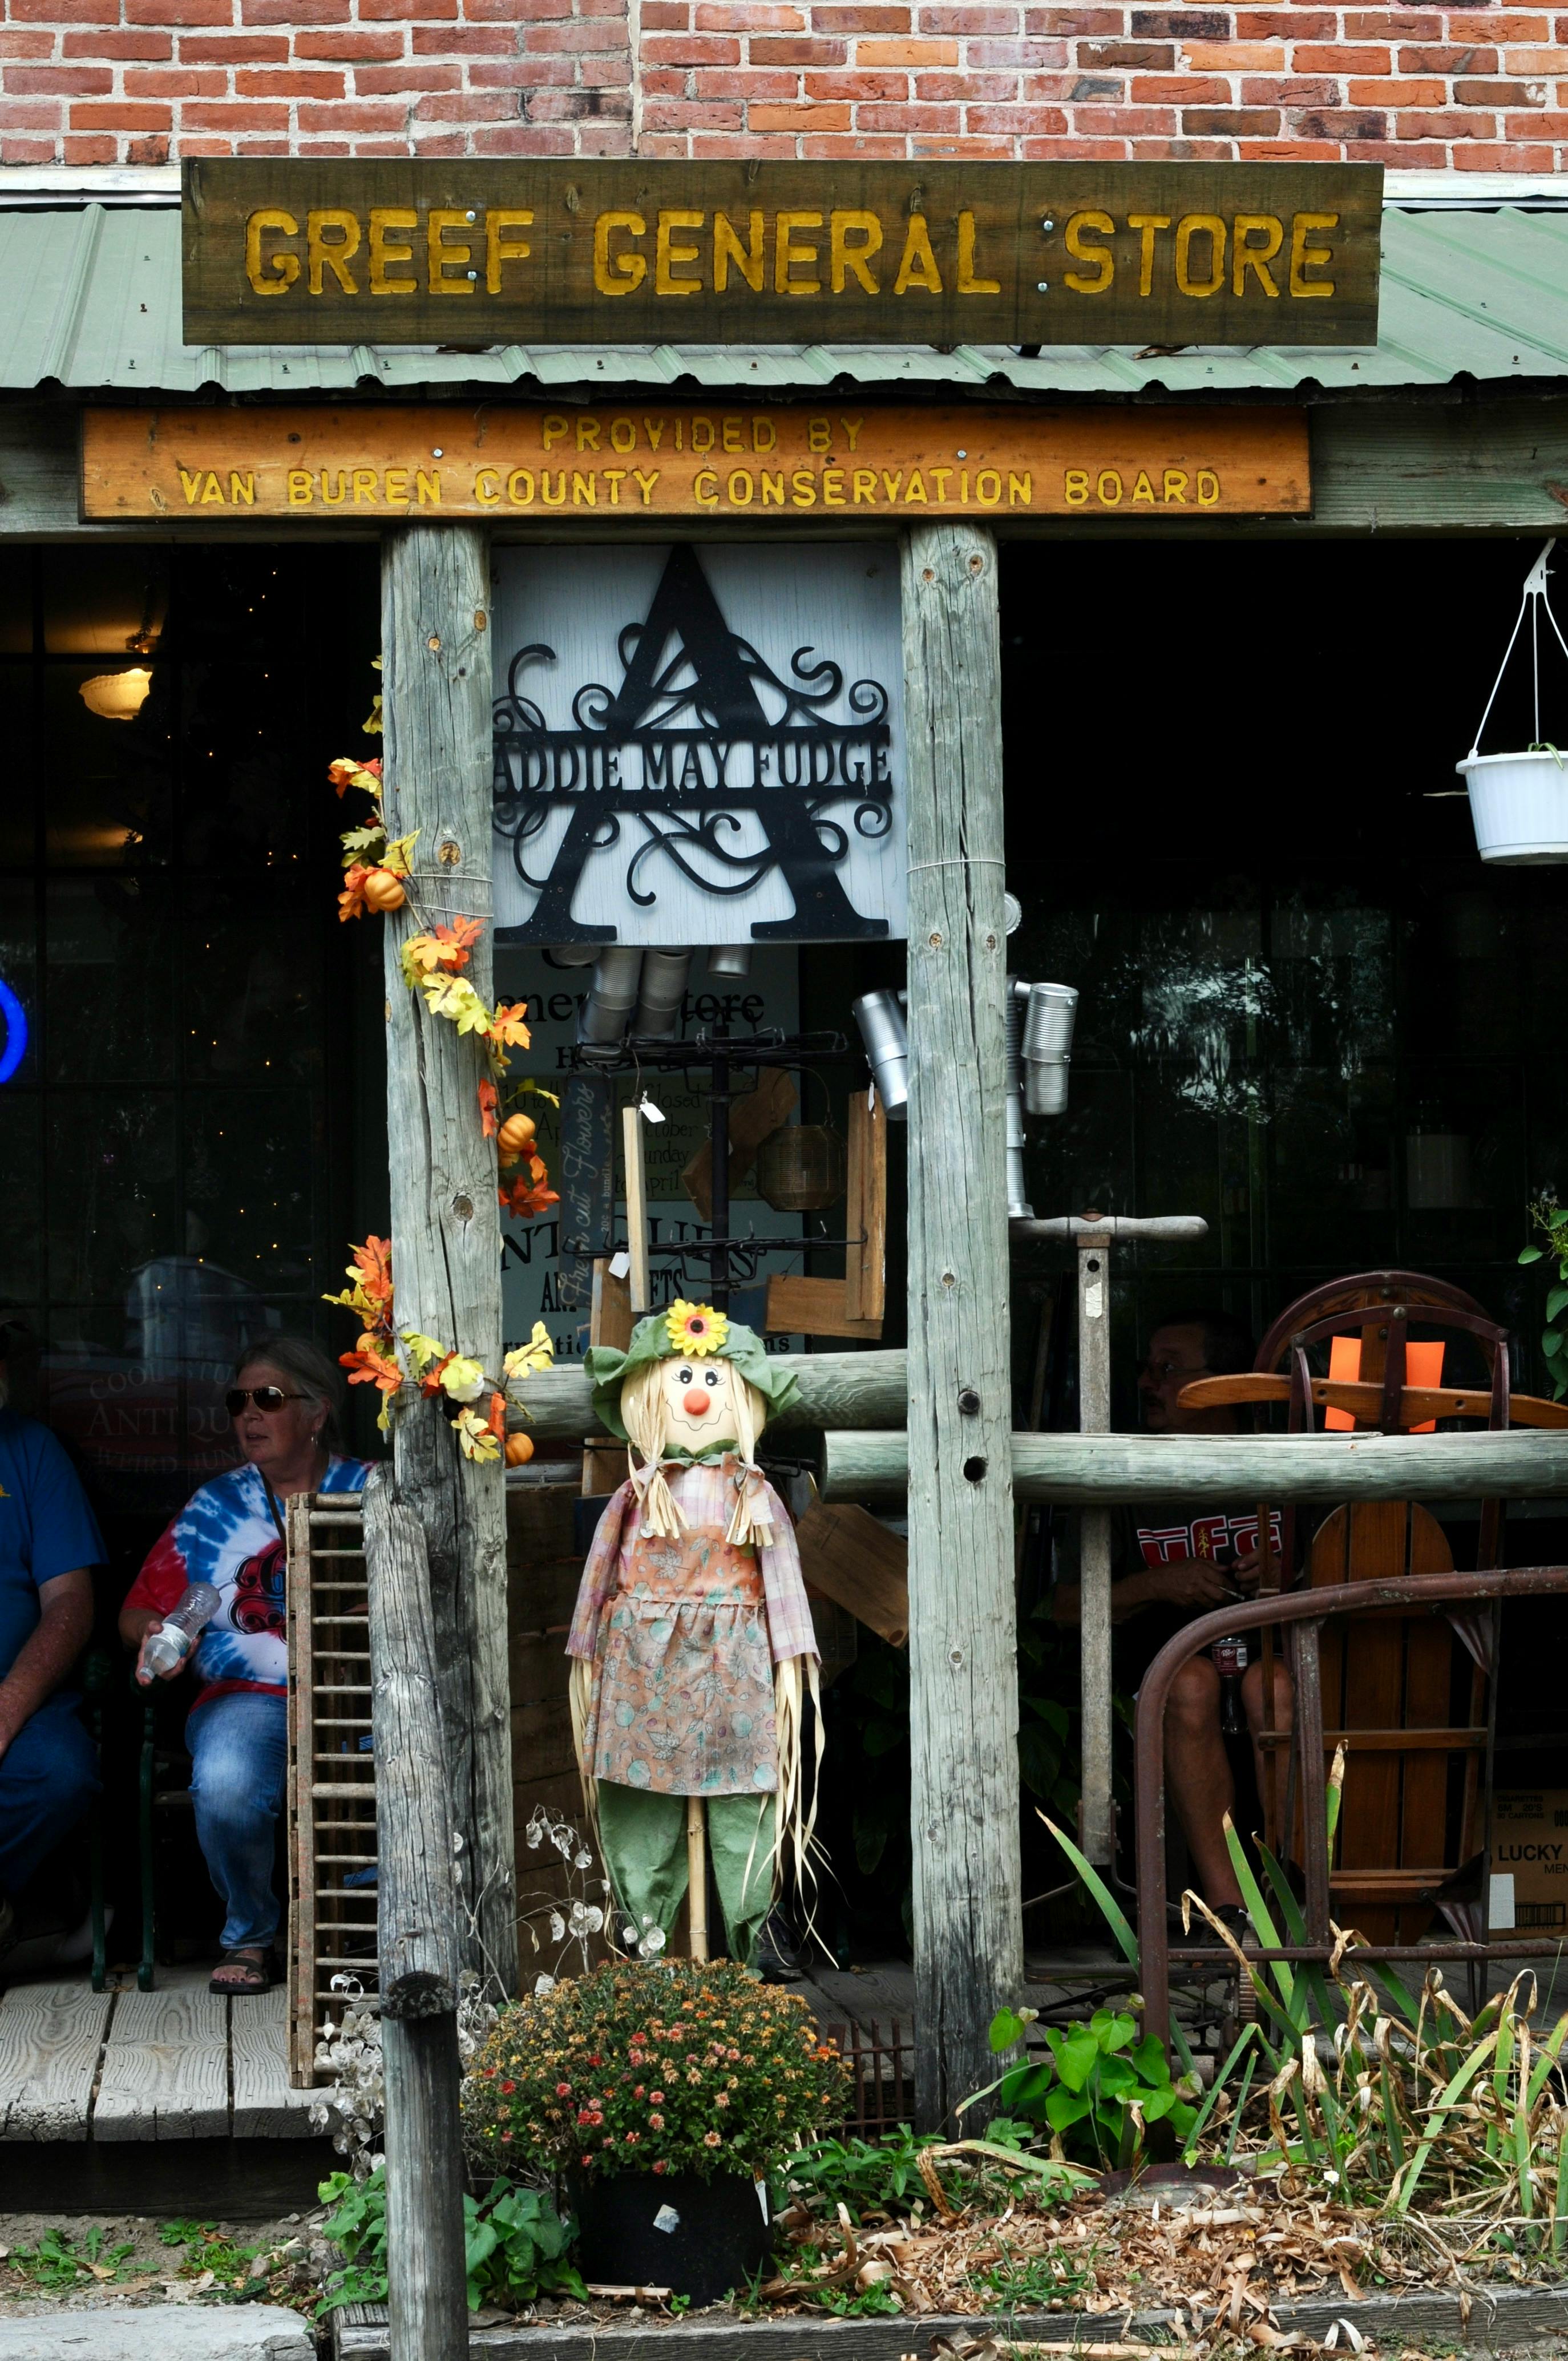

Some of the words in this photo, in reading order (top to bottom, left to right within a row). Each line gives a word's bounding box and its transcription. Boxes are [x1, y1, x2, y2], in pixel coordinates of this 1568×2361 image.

[245, 207, 535, 295] GREEF
[593, 209, 1001, 296] GENERAL
[1063, 208, 1340, 297] STORE
[542, 415, 776, 453] PROVIDED
[808, 417, 864, 453] BY
[180, 470, 254, 506] VAN
[288, 468, 442, 506] BUREN
[474, 468, 661, 506] COUNTY
[693, 467, 1032, 507] CONSERVATION
[1064, 468, 1221, 506] BOARD
[642, 739, 731, 791] MAY
[753, 737, 891, 790] FUDGE
[681, 989, 765, 1023] tore
[561, 1082, 599, 1180] Flowers
[644, 1113, 699, 1138] ctober
[644, 1140, 690, 1169] unday
[645, 1169, 680, 1197] pril
[569, 1184, 592, 1227] cut
[86, 1402, 232, 1442] ANTIQU
[1498, 1843, 1563, 1861] LUCKY
